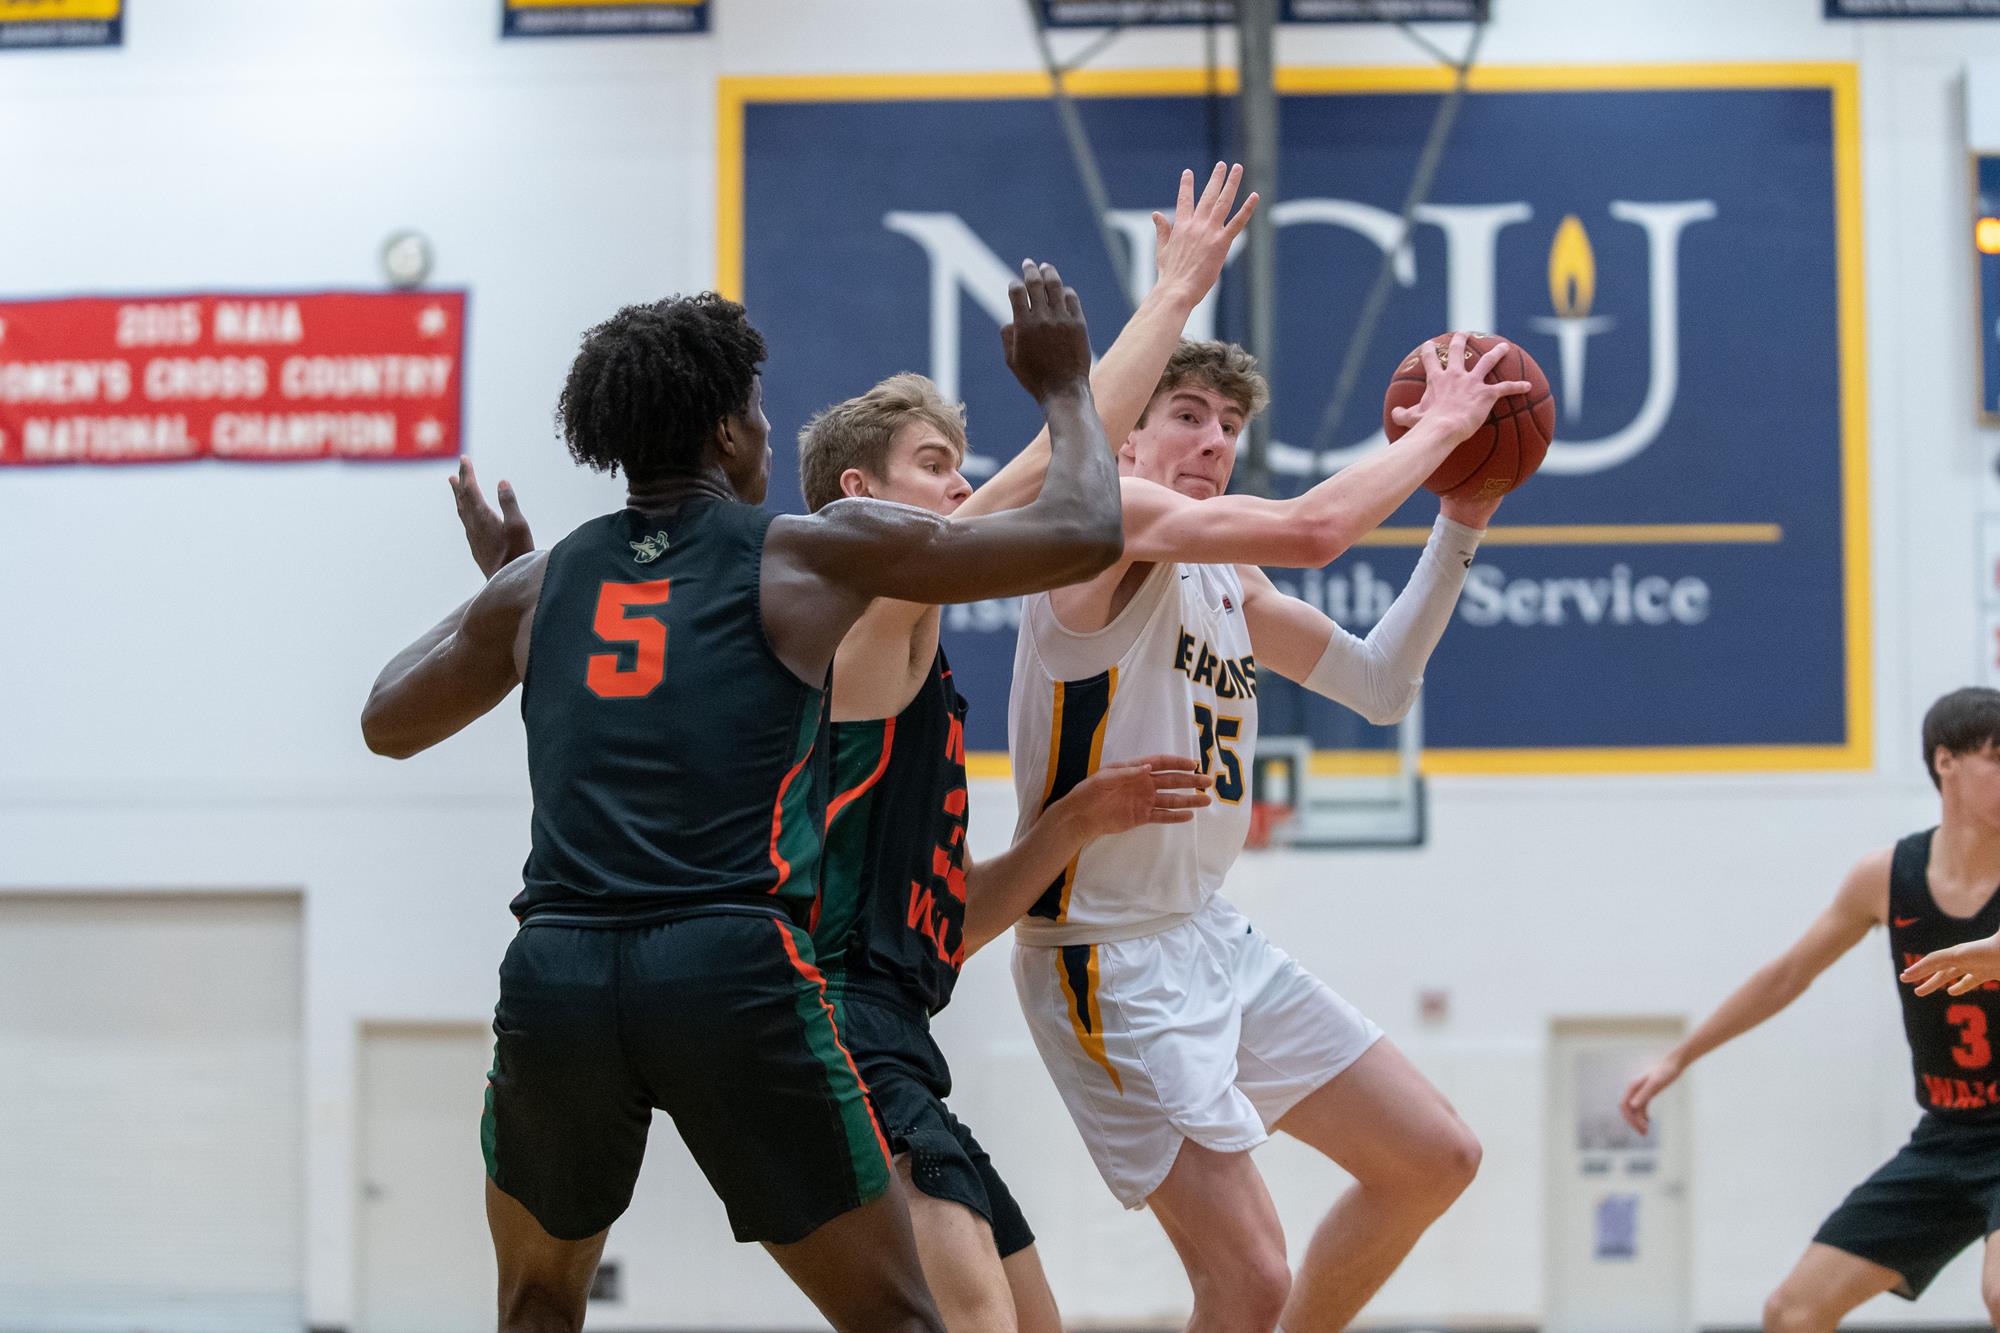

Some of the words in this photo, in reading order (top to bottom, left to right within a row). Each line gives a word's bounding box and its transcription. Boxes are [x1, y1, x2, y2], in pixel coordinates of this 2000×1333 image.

[116, 303, 201, 346] 2015
[214, 302, 303, 344] NAIA
[0, 360, 132, 402] OMEN'S
[144, 355, 268, 400] CROSS
[281, 354, 452, 399] COUNTRY
[24, 414, 199, 458] NATIONAL
[212, 411, 396, 455] CHAMPION
[1459, 563, 1709, 626] Service
[584, 578, 672, 698] 5
[1946, 1003, 1992, 1069] 3
